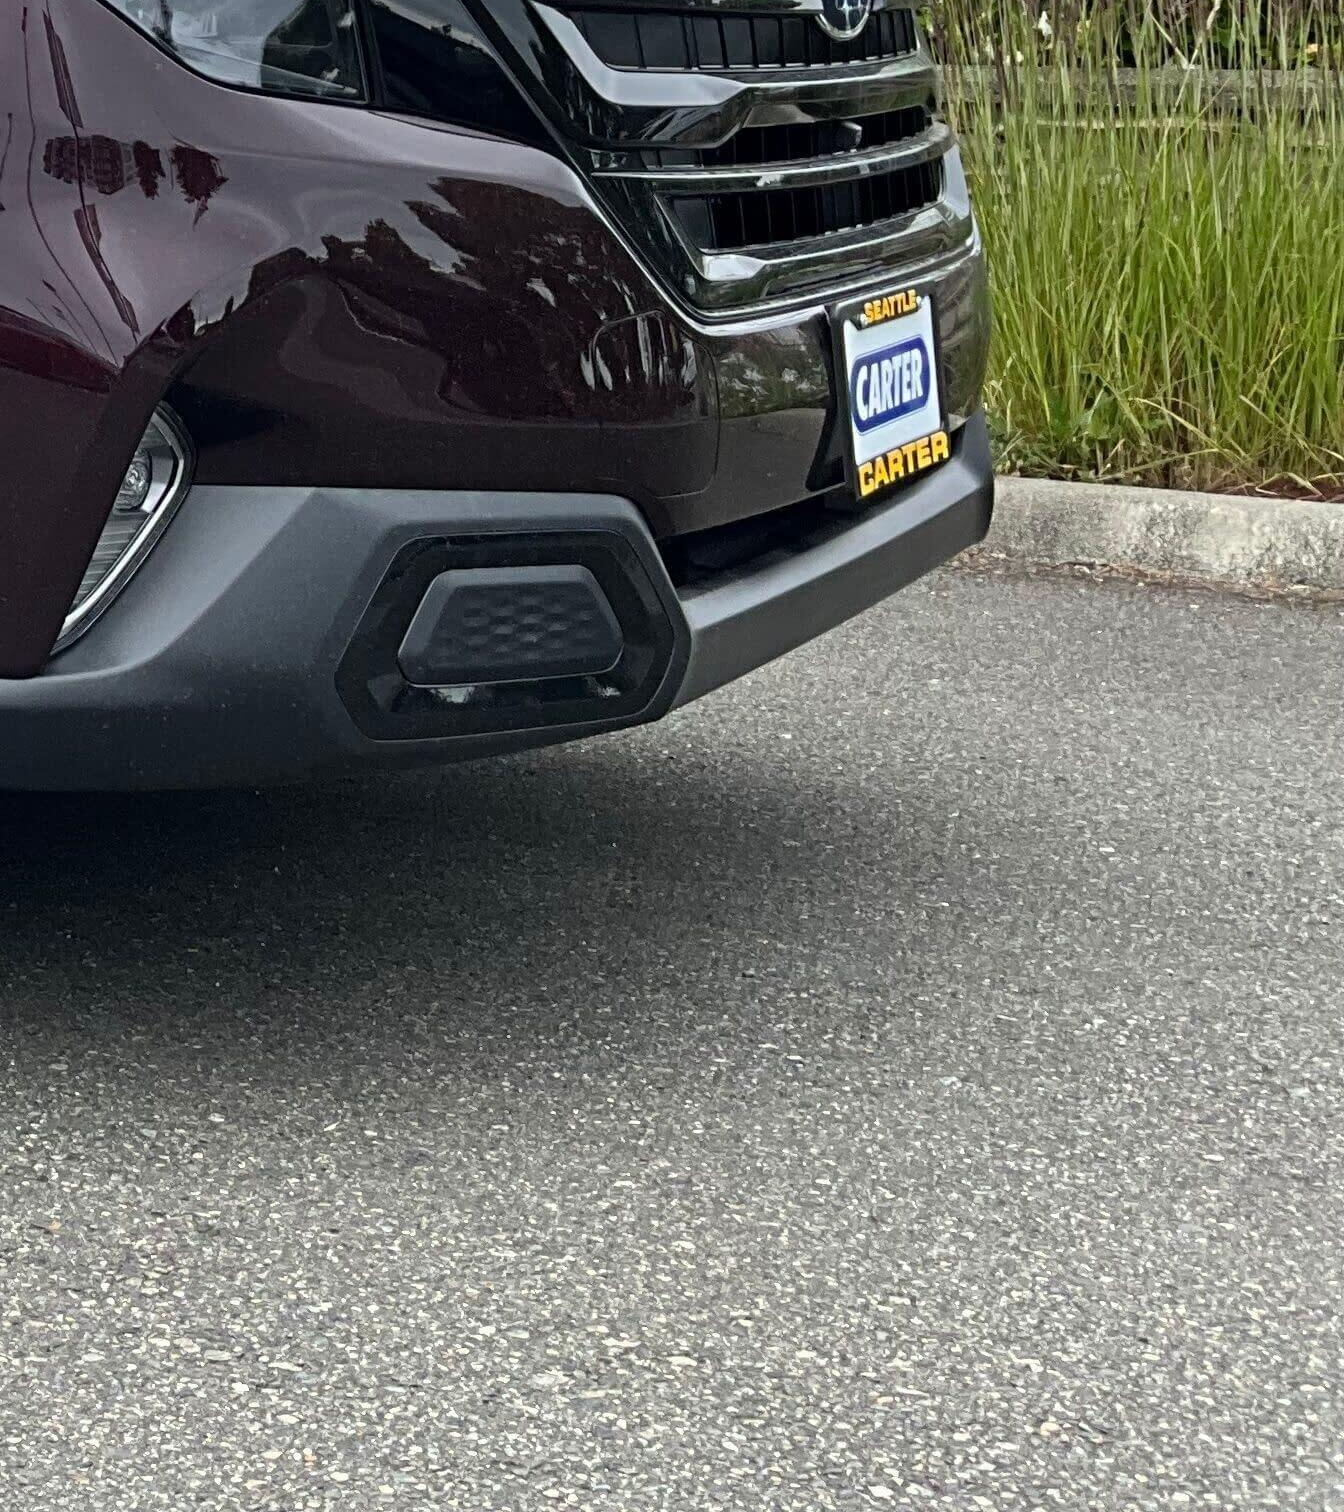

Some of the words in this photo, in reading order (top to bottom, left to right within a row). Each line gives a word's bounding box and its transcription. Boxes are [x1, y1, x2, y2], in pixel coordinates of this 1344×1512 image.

[863, 290, 917, 323] SEATTLE
[856, 348, 923, 421] CARTER
[859, 431, 949, 496] CARTER
